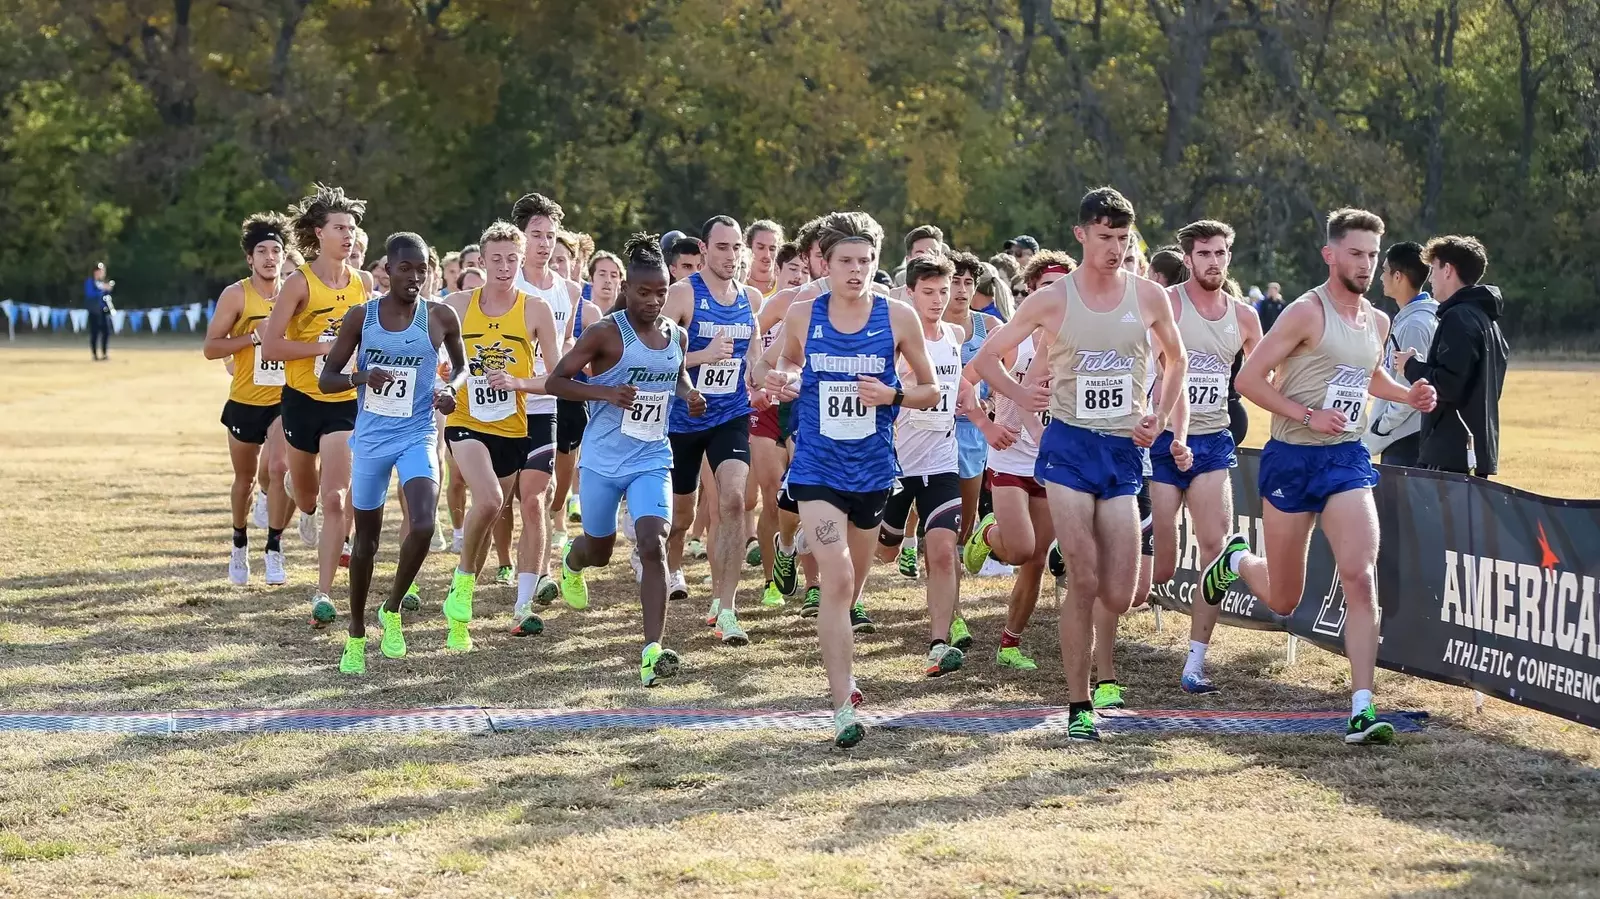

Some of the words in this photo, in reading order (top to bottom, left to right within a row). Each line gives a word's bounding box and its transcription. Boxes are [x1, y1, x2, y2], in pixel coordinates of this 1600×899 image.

[812, 325, 823, 338] A
[365, 349, 424, 366] TULANE
[809, 353, 886, 376] Memphis
[1072, 349, 1135, 372] Tulsa
[704, 369, 735, 386] 847
[1085, 378, 1123, 386] AMERICAN
[475, 387, 508, 405] 896
[1085, 388, 1123, 409] 885
[1188, 386, 1219, 404] 876
[1336, 389, 1363, 398] AMERICAN
[631, 403, 662, 422] 871
[828, 396, 867, 417] 840
[1441, 550, 1600, 660] AMERICA
[1443, 638, 1514, 679] ATHLETIC
[1517, 656, 1600, 703] CONFERENC
